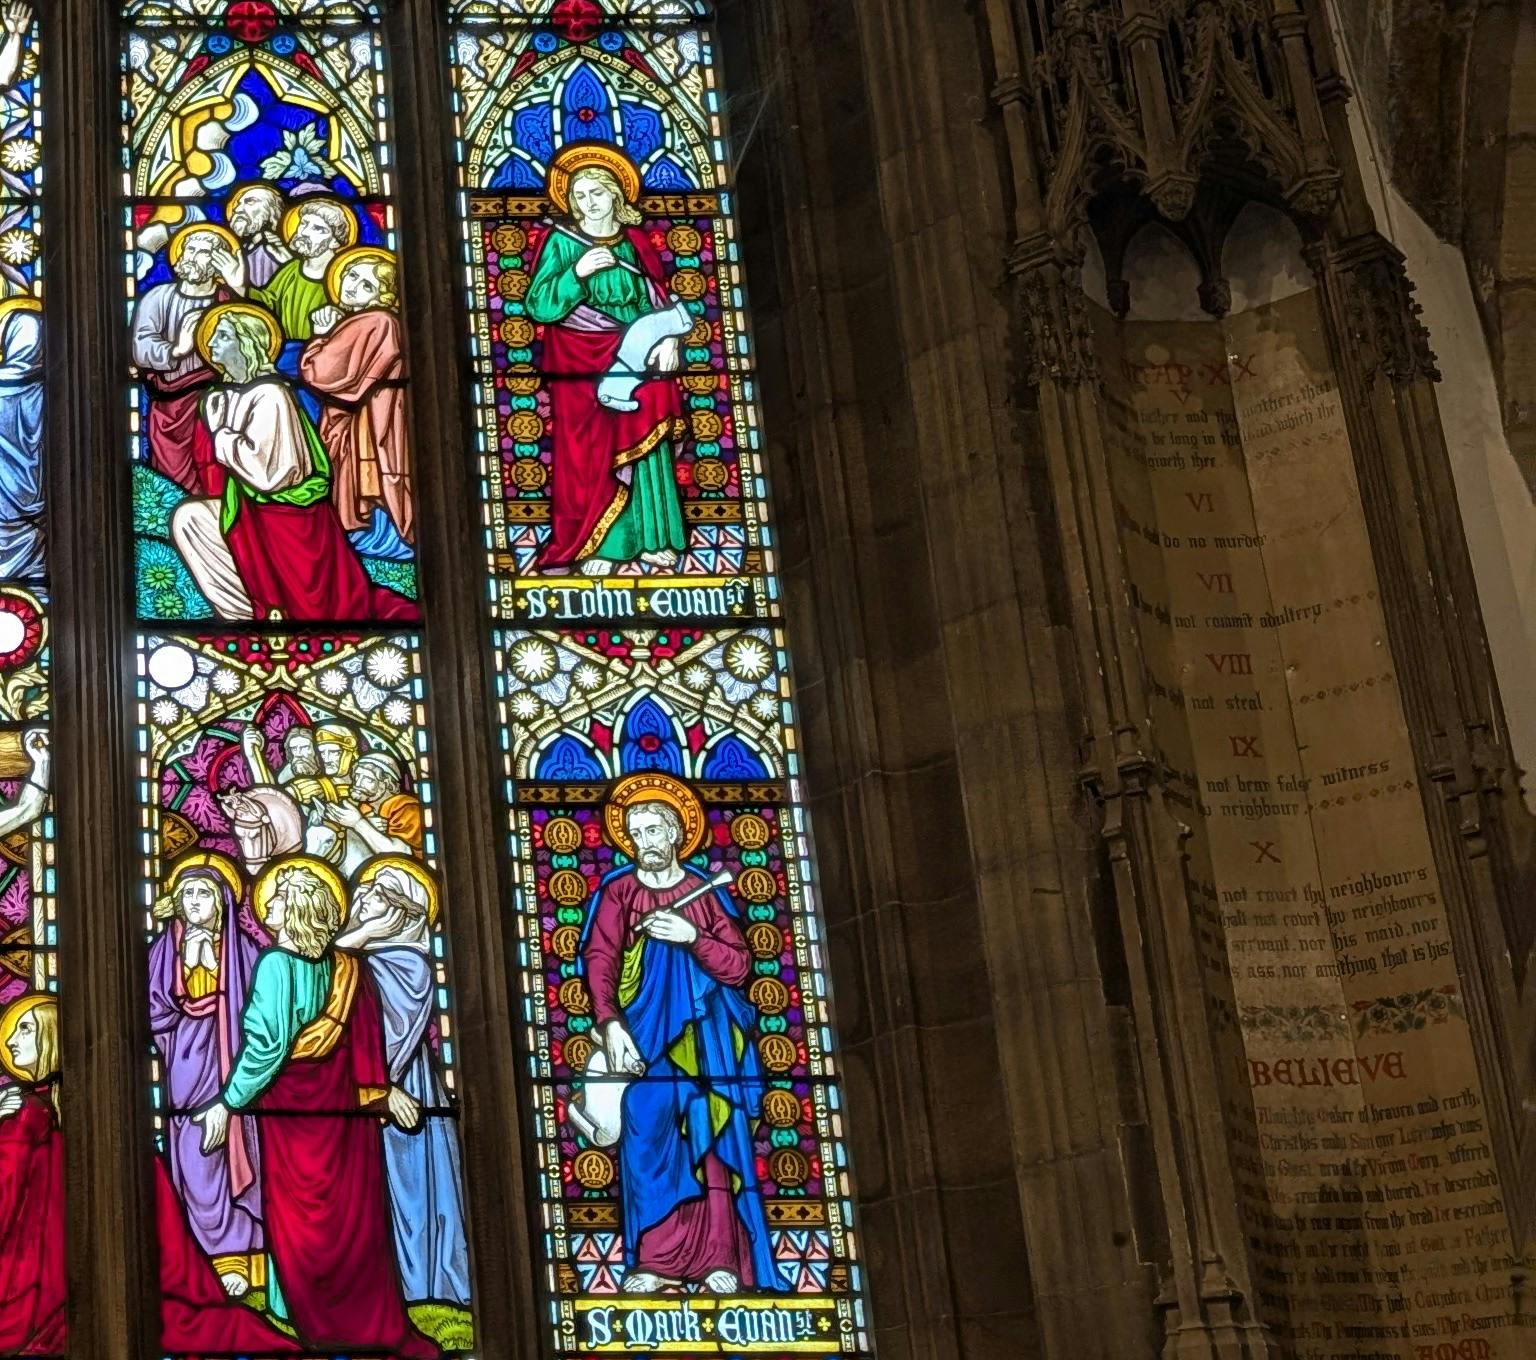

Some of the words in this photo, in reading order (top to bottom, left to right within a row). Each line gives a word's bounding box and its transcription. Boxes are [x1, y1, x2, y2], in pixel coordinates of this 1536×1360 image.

[1185, 491, 1216, 513] VI
[1195, 571, 1235, 594] VII
[1206, 653, 1256, 677] VIII
[1228, 735, 1264, 759] IX
[1249, 840, 1283, 865] X
[1247, 1050, 1406, 1088] BELIEVE
